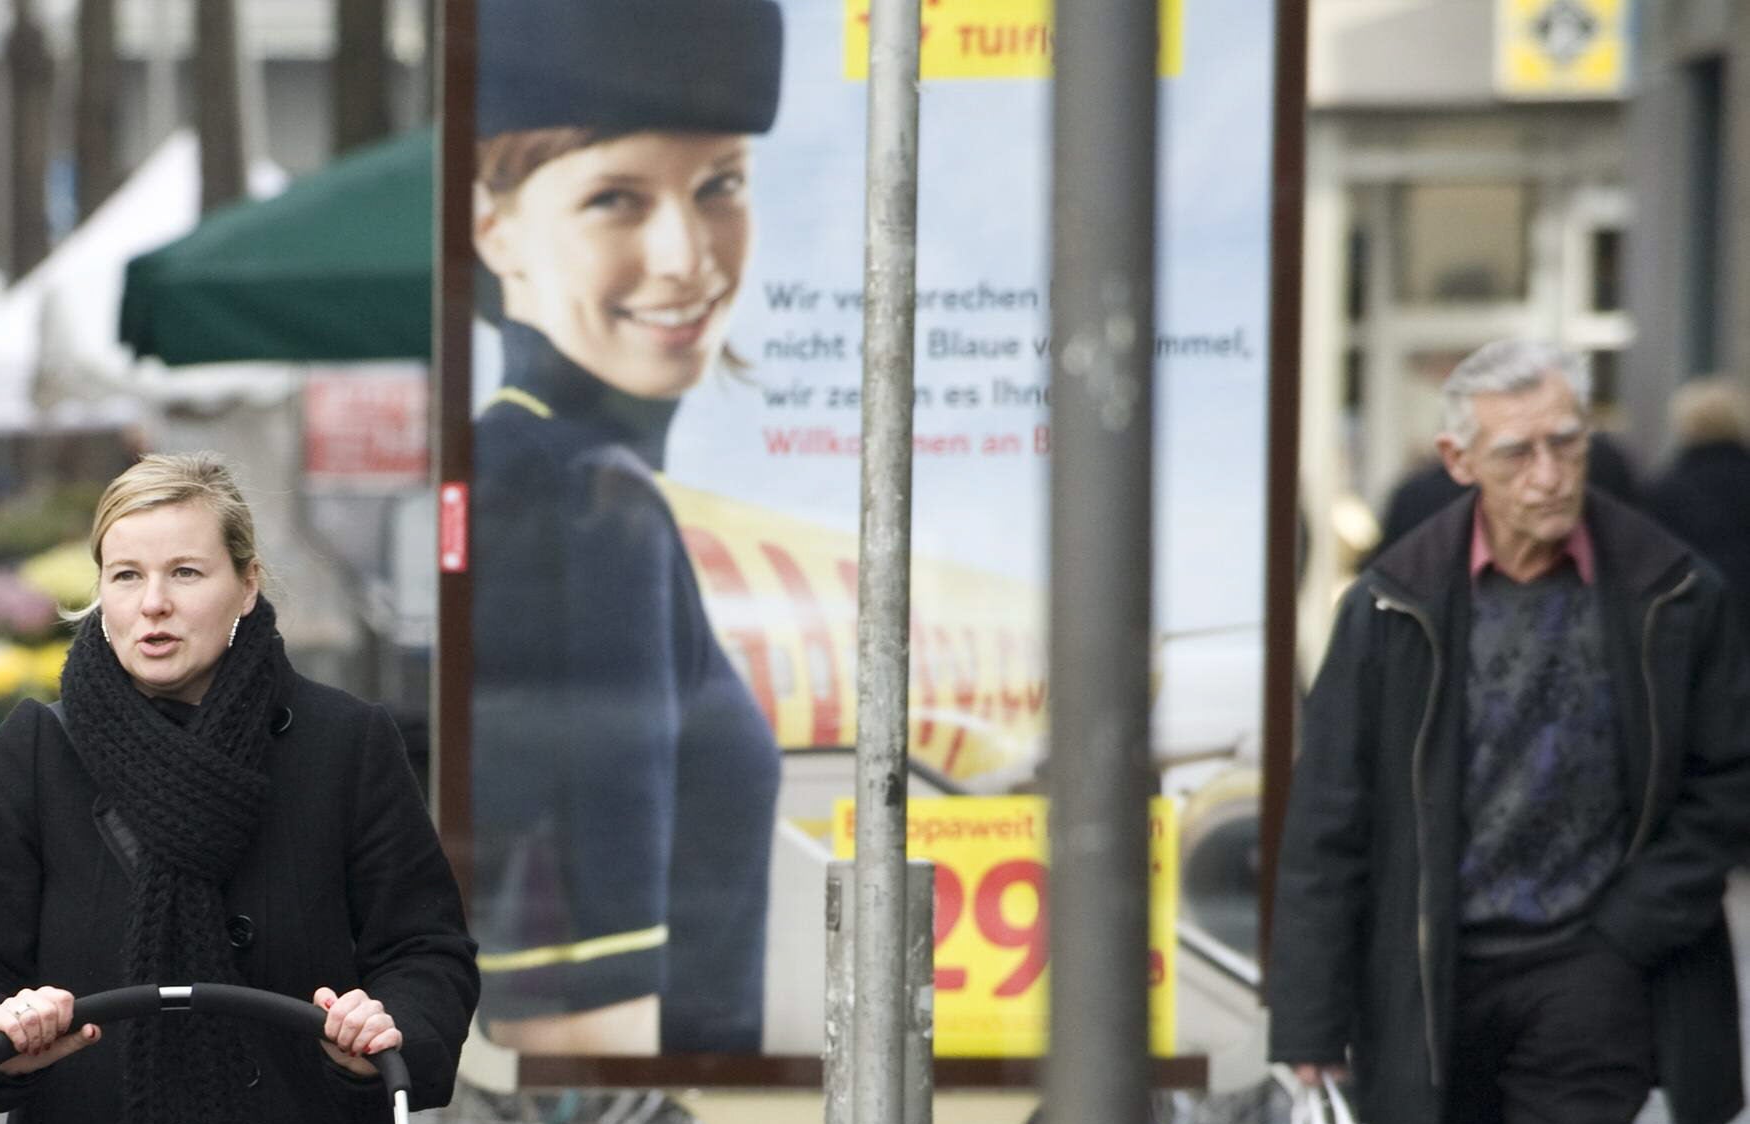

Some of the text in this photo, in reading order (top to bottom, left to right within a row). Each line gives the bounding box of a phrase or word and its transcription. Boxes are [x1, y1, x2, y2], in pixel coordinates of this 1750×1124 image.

[763, 279, 1038, 310] Wir verechen
[763, 328, 846, 359] nicht
[926, 328, 1020, 360] Blaue
[1155, 326, 1251, 359] mmel,
[762, 379, 812, 408] wir
[944, 384, 980, 409] es
[981, 432, 1021, 455] an
